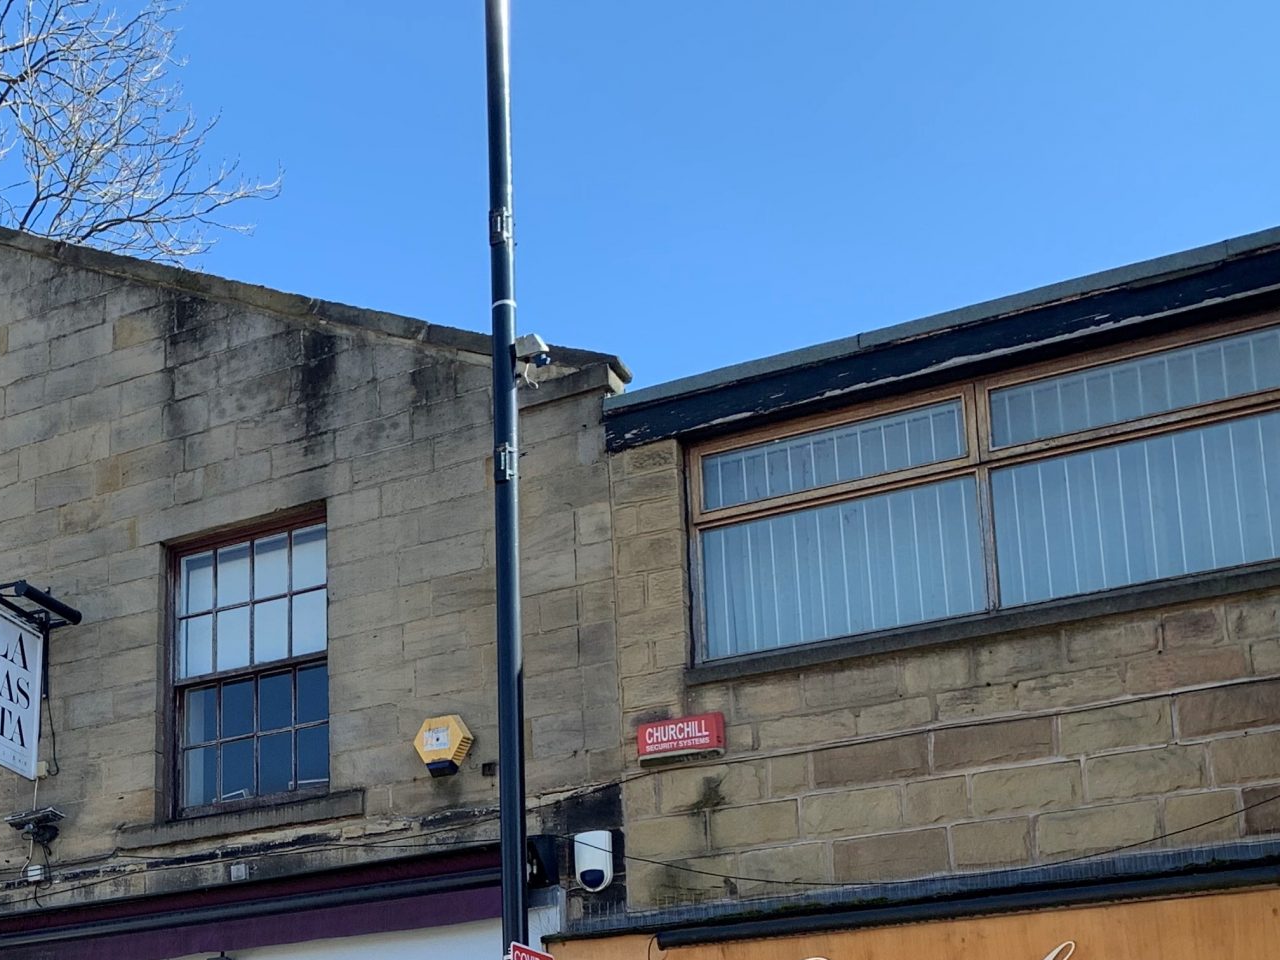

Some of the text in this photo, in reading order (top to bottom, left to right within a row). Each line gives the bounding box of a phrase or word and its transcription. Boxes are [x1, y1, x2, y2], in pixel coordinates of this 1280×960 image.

[645, 719, 710, 744] CHURCHILL
[645, 736, 710, 752] SECURITY SYSTEMS
